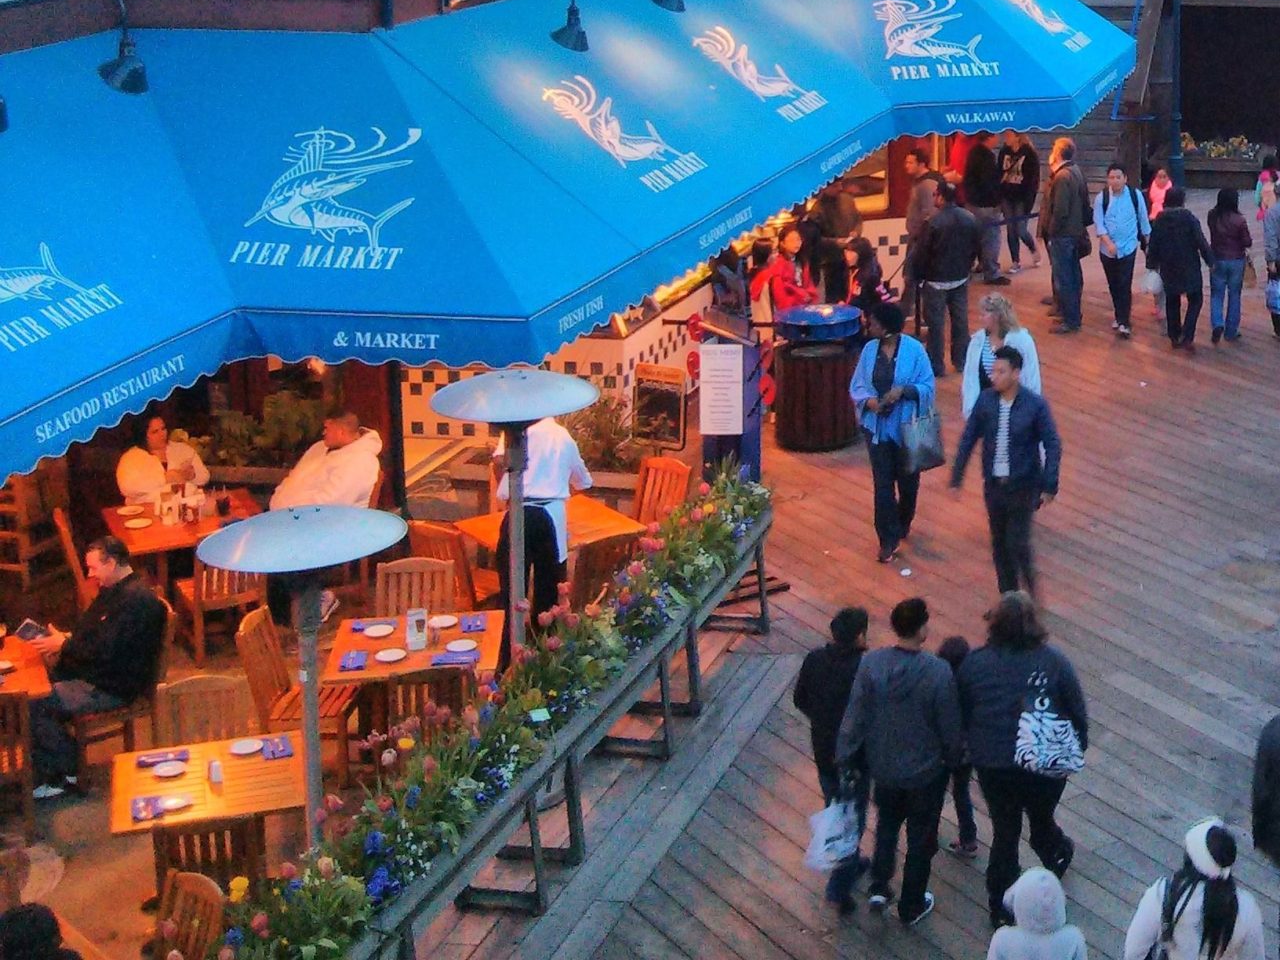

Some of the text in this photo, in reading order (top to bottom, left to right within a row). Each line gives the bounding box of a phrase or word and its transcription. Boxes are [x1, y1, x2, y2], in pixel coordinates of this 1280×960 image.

[890, 61, 1000, 81] PIER MARKET
[945, 111, 1016, 125] WALKAWAY
[639, 152, 708, 193] PIER MARKET
[699, 205, 753, 250] SEAFOOD MARKET
[230, 241, 403, 270] PIER MARKET
[0, 283, 124, 352] PIER MARKET
[558, 296, 604, 335] FRESH FISH
[333, 331, 439, 350] & MARKET
[35, 354, 186, 443] SEAFOOD RESTAURANT
